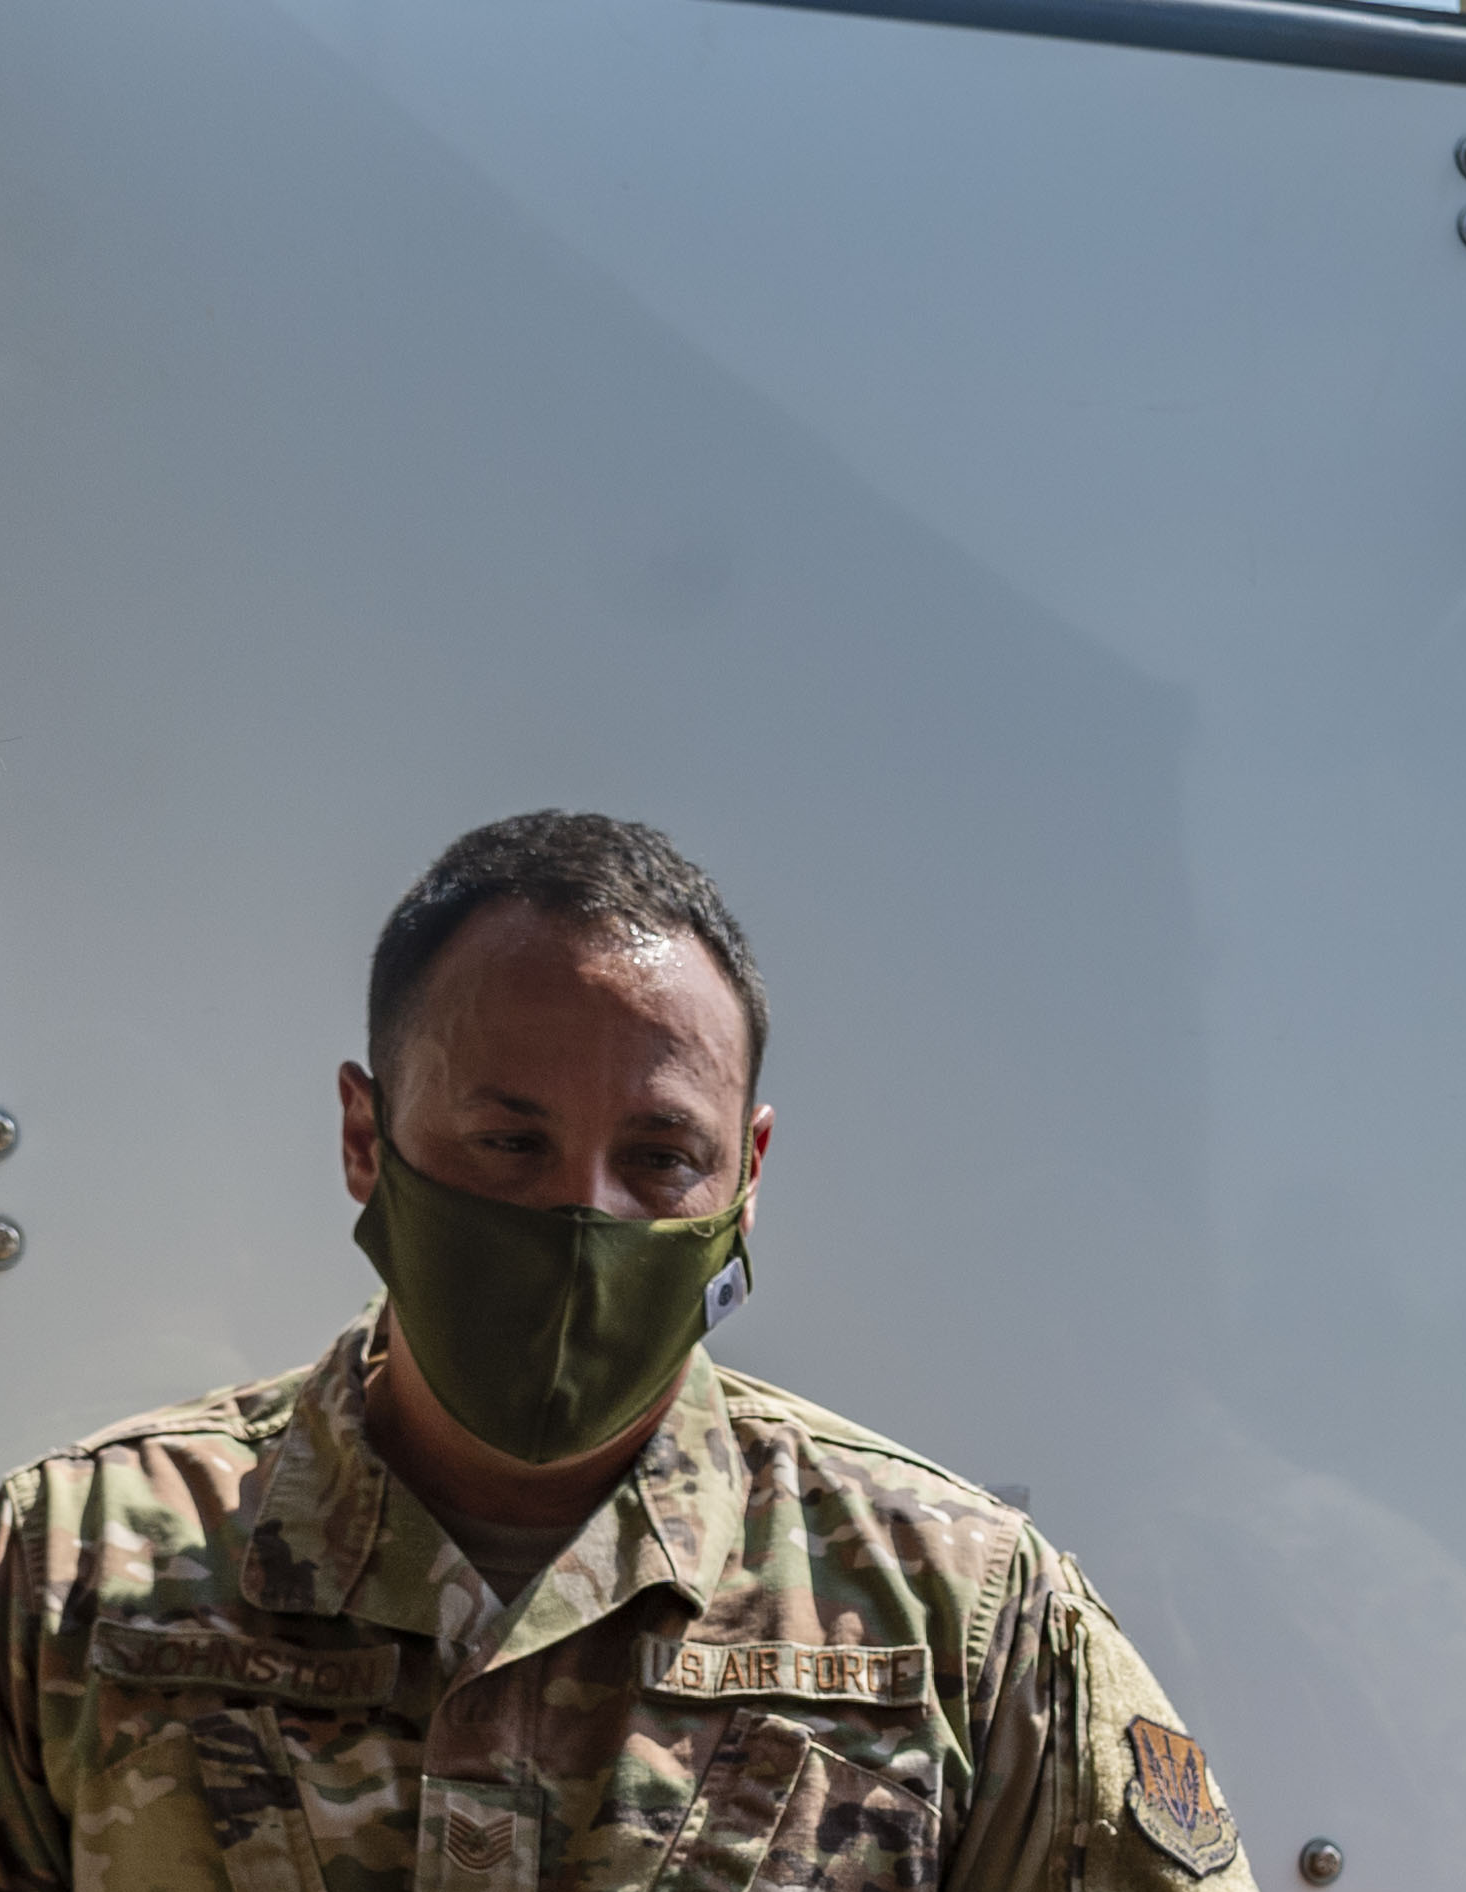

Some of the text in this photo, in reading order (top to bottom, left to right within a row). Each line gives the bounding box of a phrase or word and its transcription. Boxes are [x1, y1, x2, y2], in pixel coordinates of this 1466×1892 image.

[124, 1640, 375, 1698] JOHNSTON
[651, 1643, 911, 1698] US AIR FORCE
